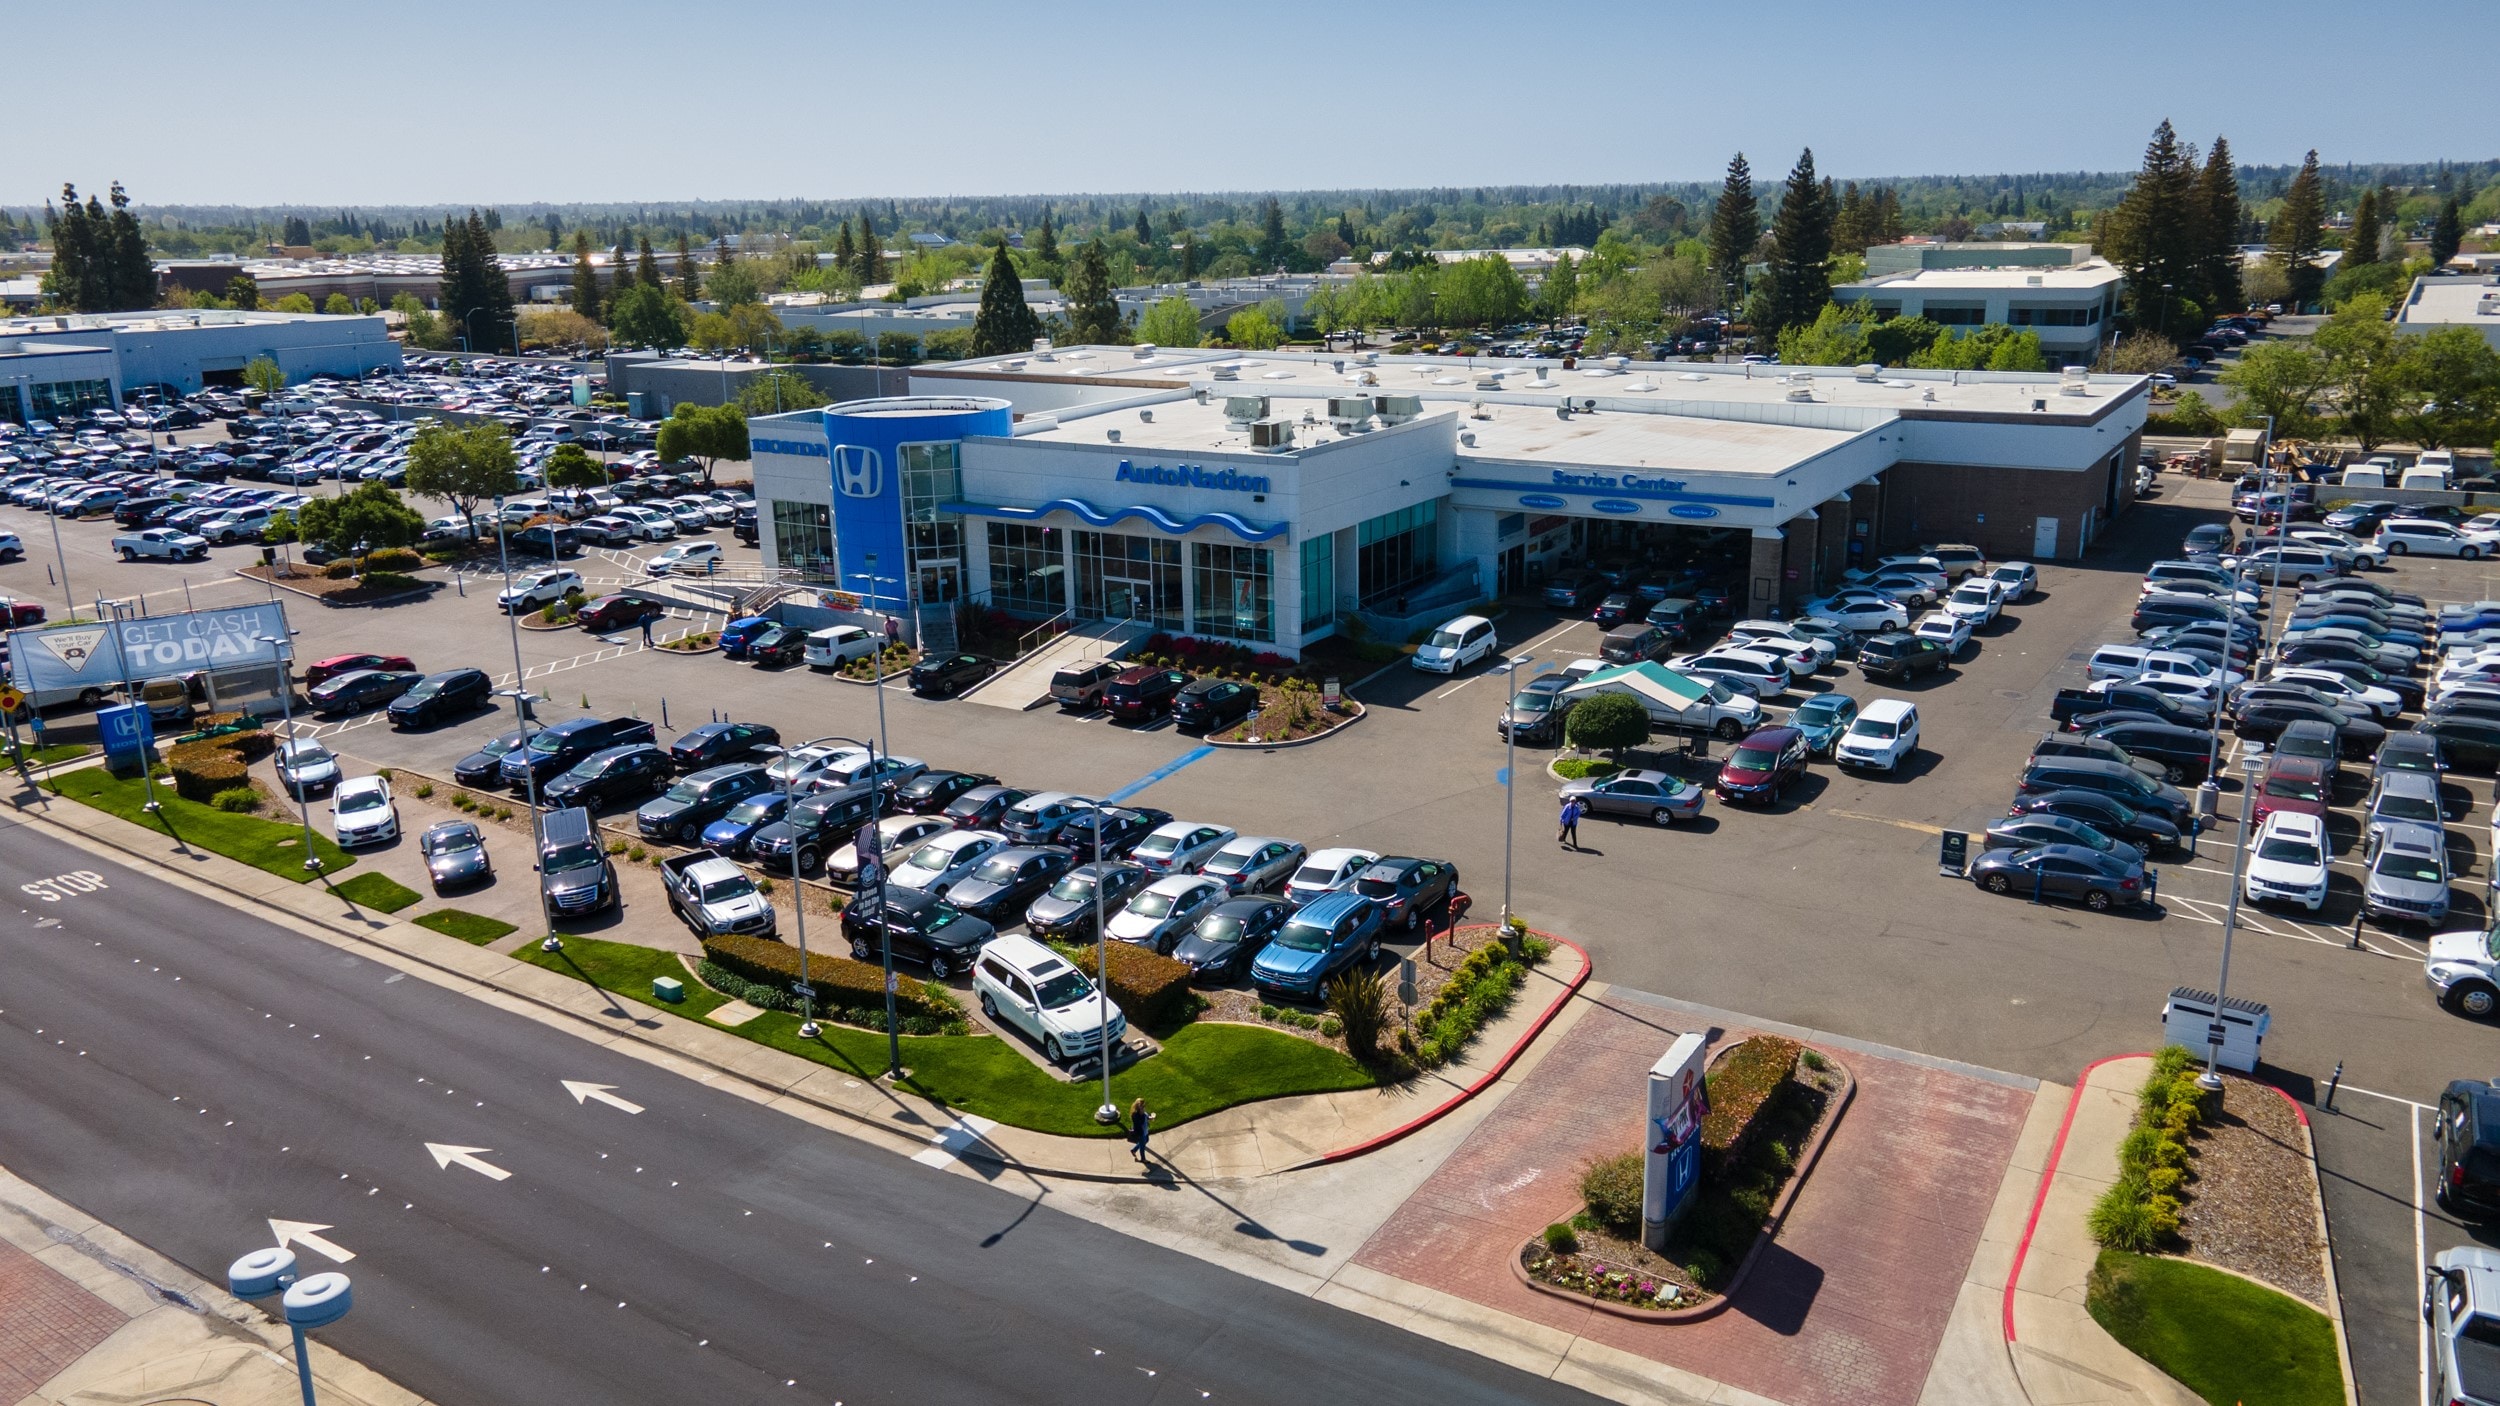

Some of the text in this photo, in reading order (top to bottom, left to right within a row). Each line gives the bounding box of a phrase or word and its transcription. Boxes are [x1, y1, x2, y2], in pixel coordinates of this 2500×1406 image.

[1115, 459, 1271, 494] AutoNation
[1553, 469, 1687, 491] Service Center
[123, 611, 261, 644] GET CASH
[125, 629, 262, 667] TODAY
[20, 870, 110, 902] STOP
